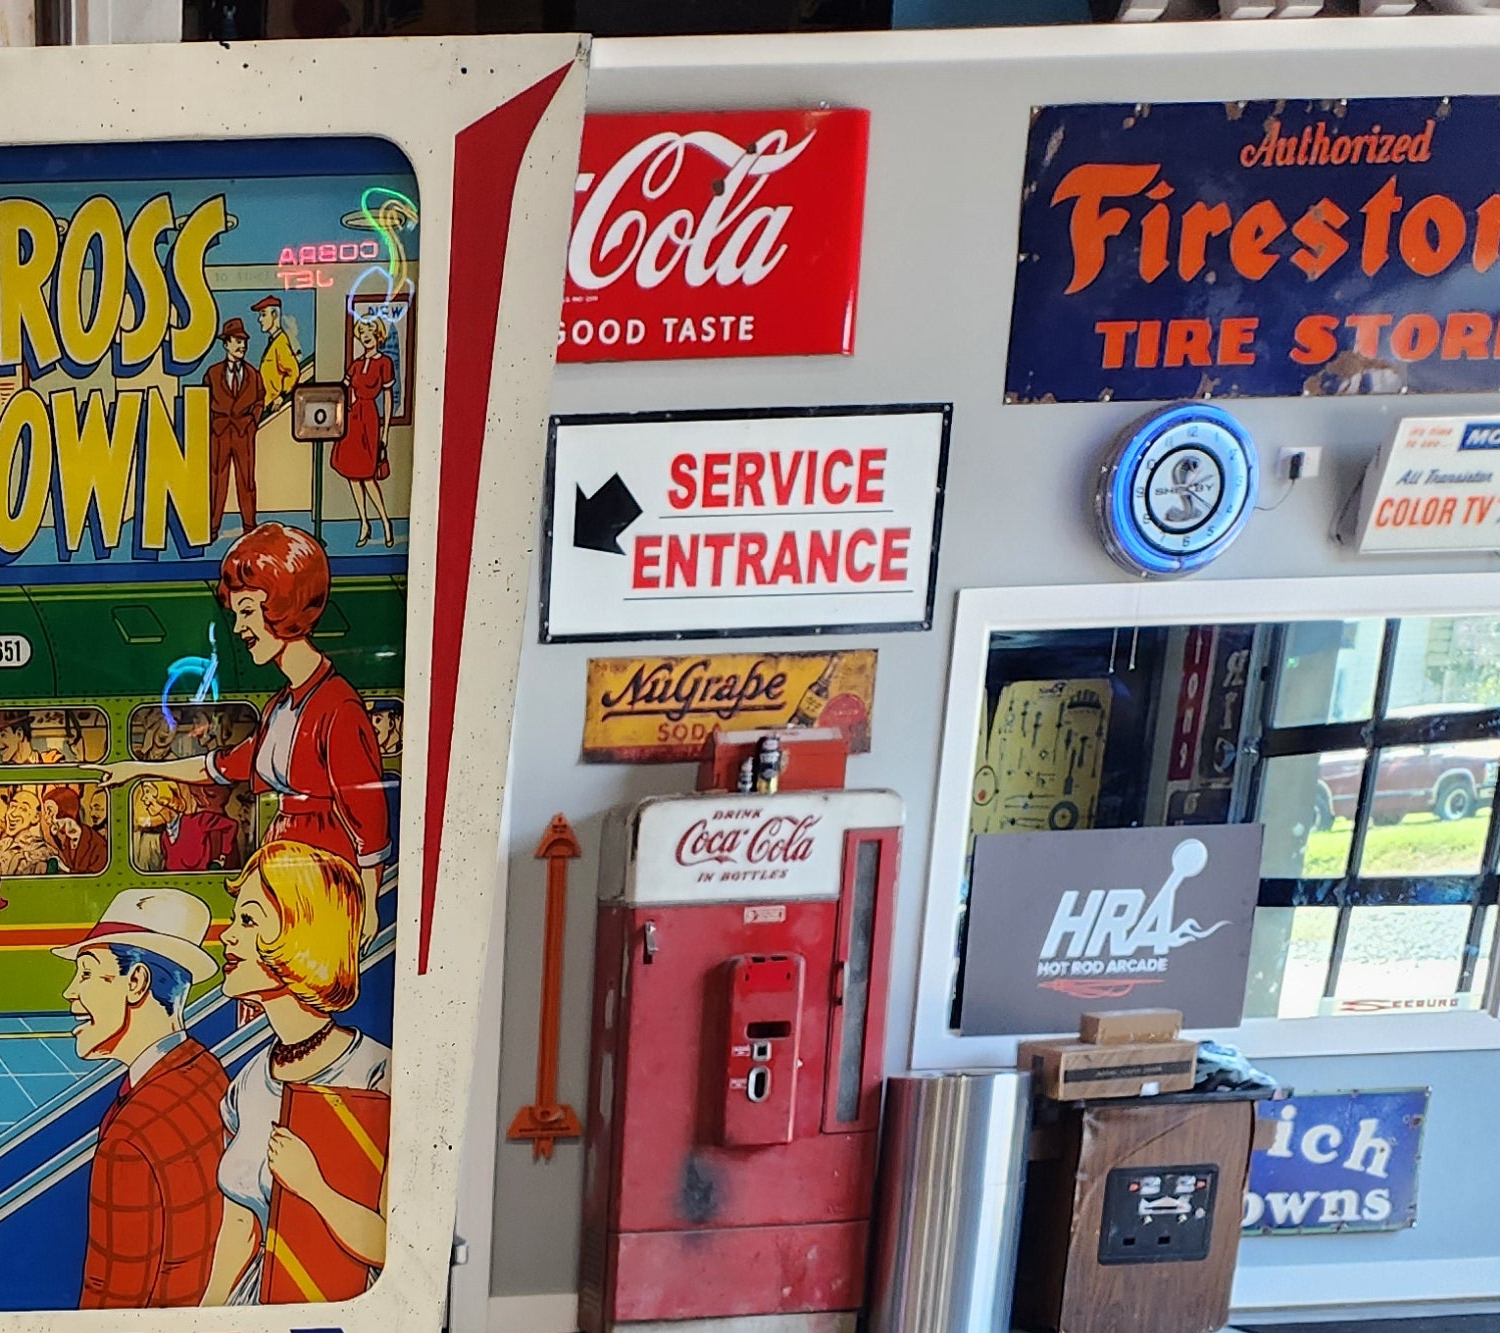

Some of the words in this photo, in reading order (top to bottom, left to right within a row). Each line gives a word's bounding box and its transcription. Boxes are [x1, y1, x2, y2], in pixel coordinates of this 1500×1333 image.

[1240, 119, 1434, 168] Authorized
[662, 316, 754, 343] TASTE
[1094, 316, 1260, 370] TIRE
[667, 447, 888, 511] SERVICE
[1375, 496, 1457, 528] COLOR
[1462, 496, 1494, 525] TV
[632, 526, 912, 590] ENTRANCE
[601, 659, 788, 721] NuGrape
[713, 808, 763, 820] DRINK
[675, 814, 822, 867] Coca-Cola
[697, 872, 714, 883] IN
[720, 869, 789, 882] BOTTLES
[1040, 888, 1176, 959] HRA
[1037, 960, 1070, 977] HOT
[1071, 959, 1104, 975] ROD
[1106, 958, 1169, 974] ARCADE
